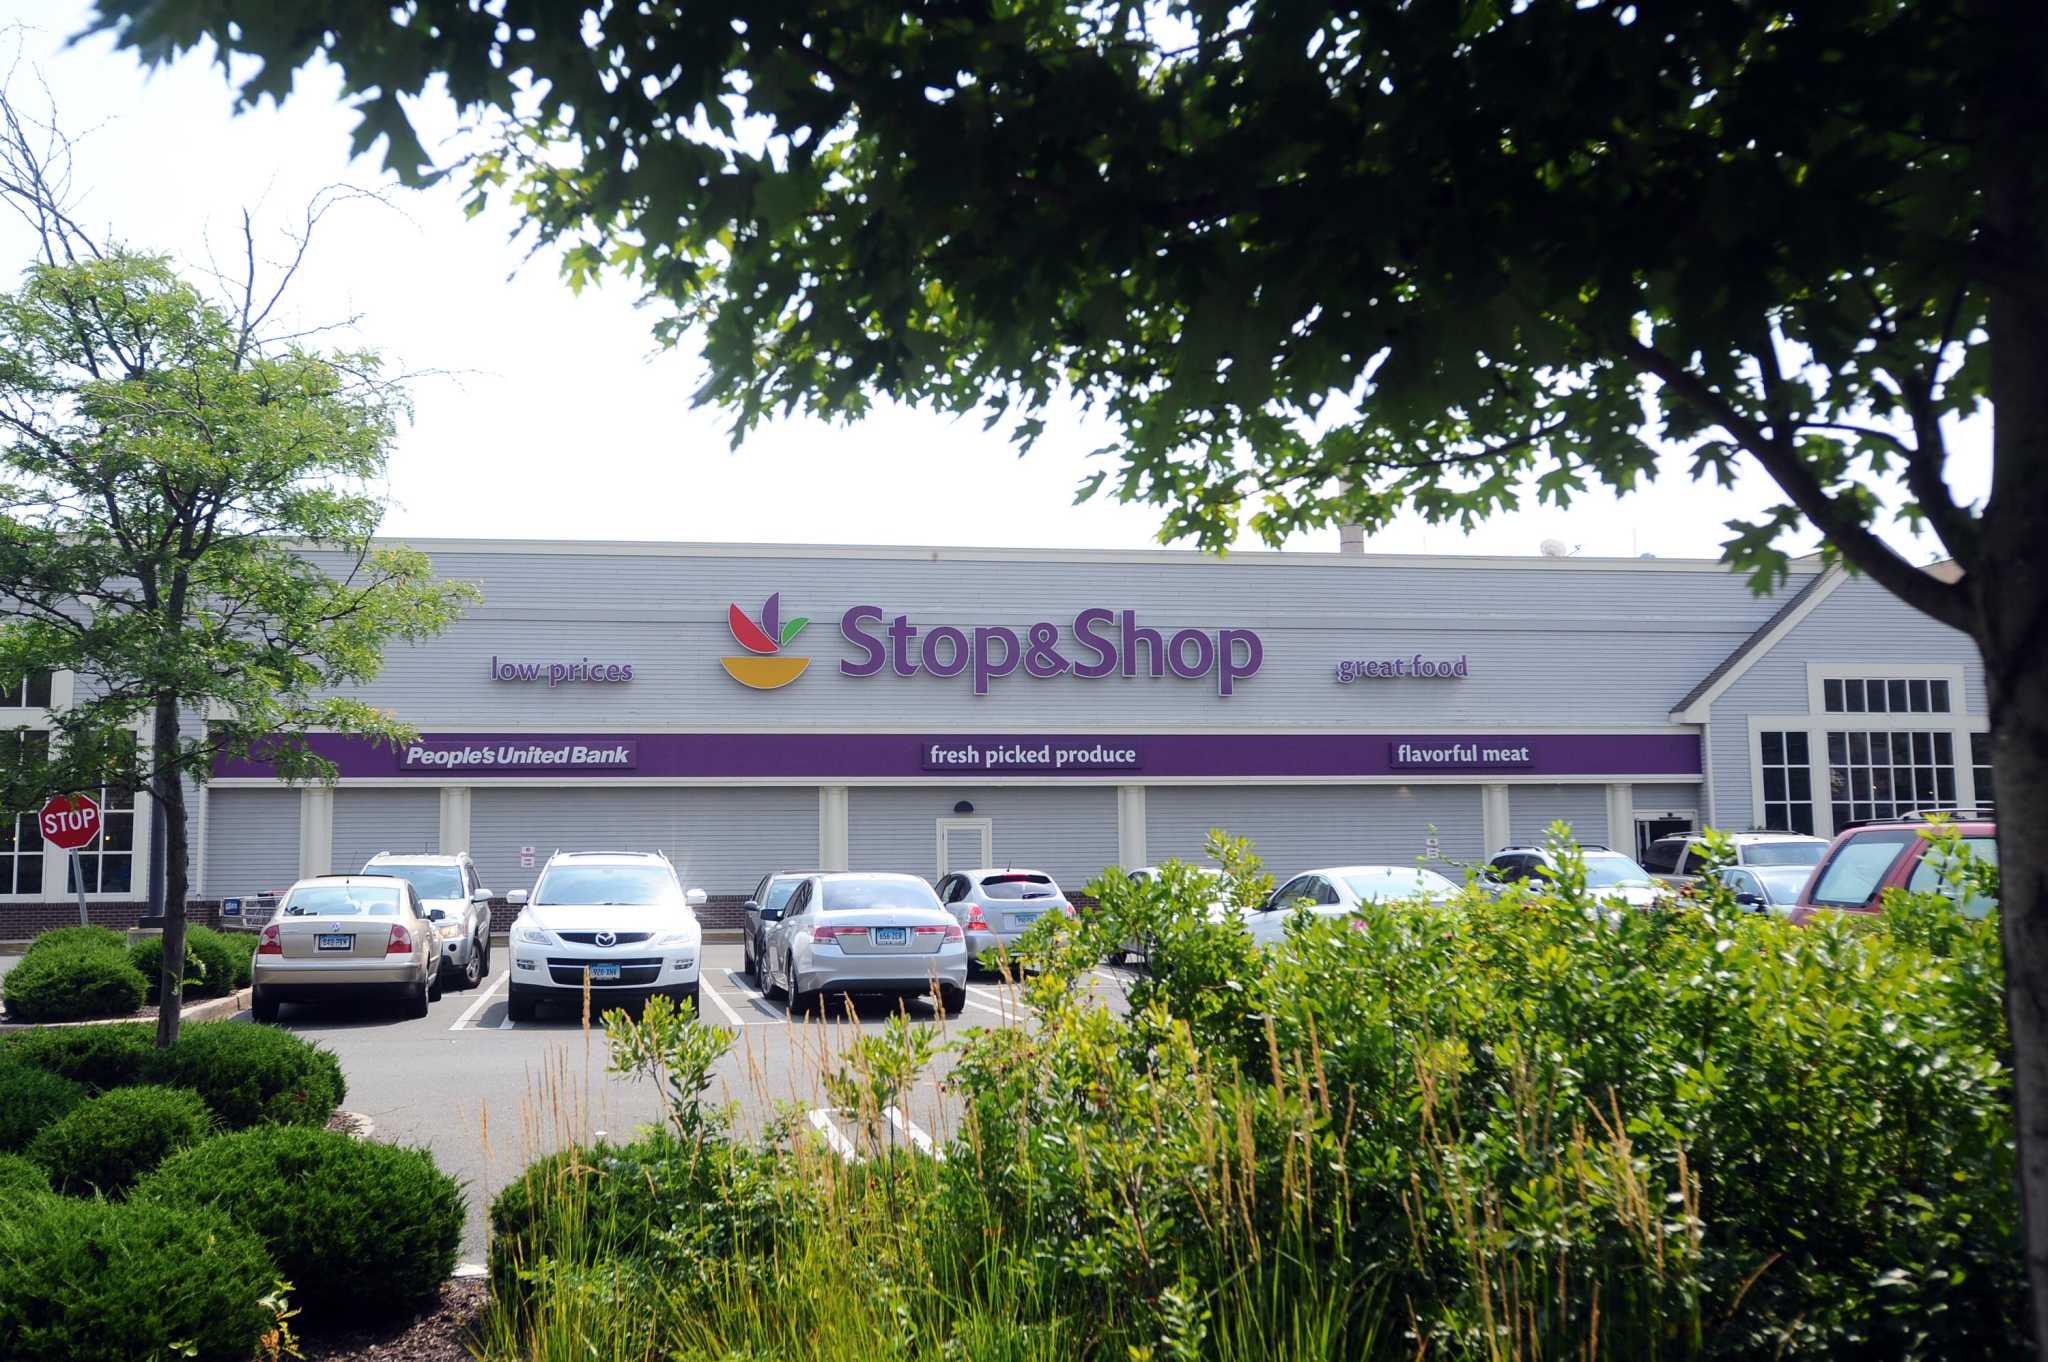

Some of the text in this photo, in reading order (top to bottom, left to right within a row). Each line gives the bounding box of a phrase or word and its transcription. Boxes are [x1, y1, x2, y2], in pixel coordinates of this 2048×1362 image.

[839, 605, 1264, 697] Stop&Shop
[491, 655, 634, 688] low prices
[1337, 654, 1470, 684] great food
[406, 746, 629, 769] People's United Bank
[930, 744, 1137, 768] fresh picked produce
[1398, 744, 1530, 763] flavorful meat
[44, 807, 96, 834] STOP
